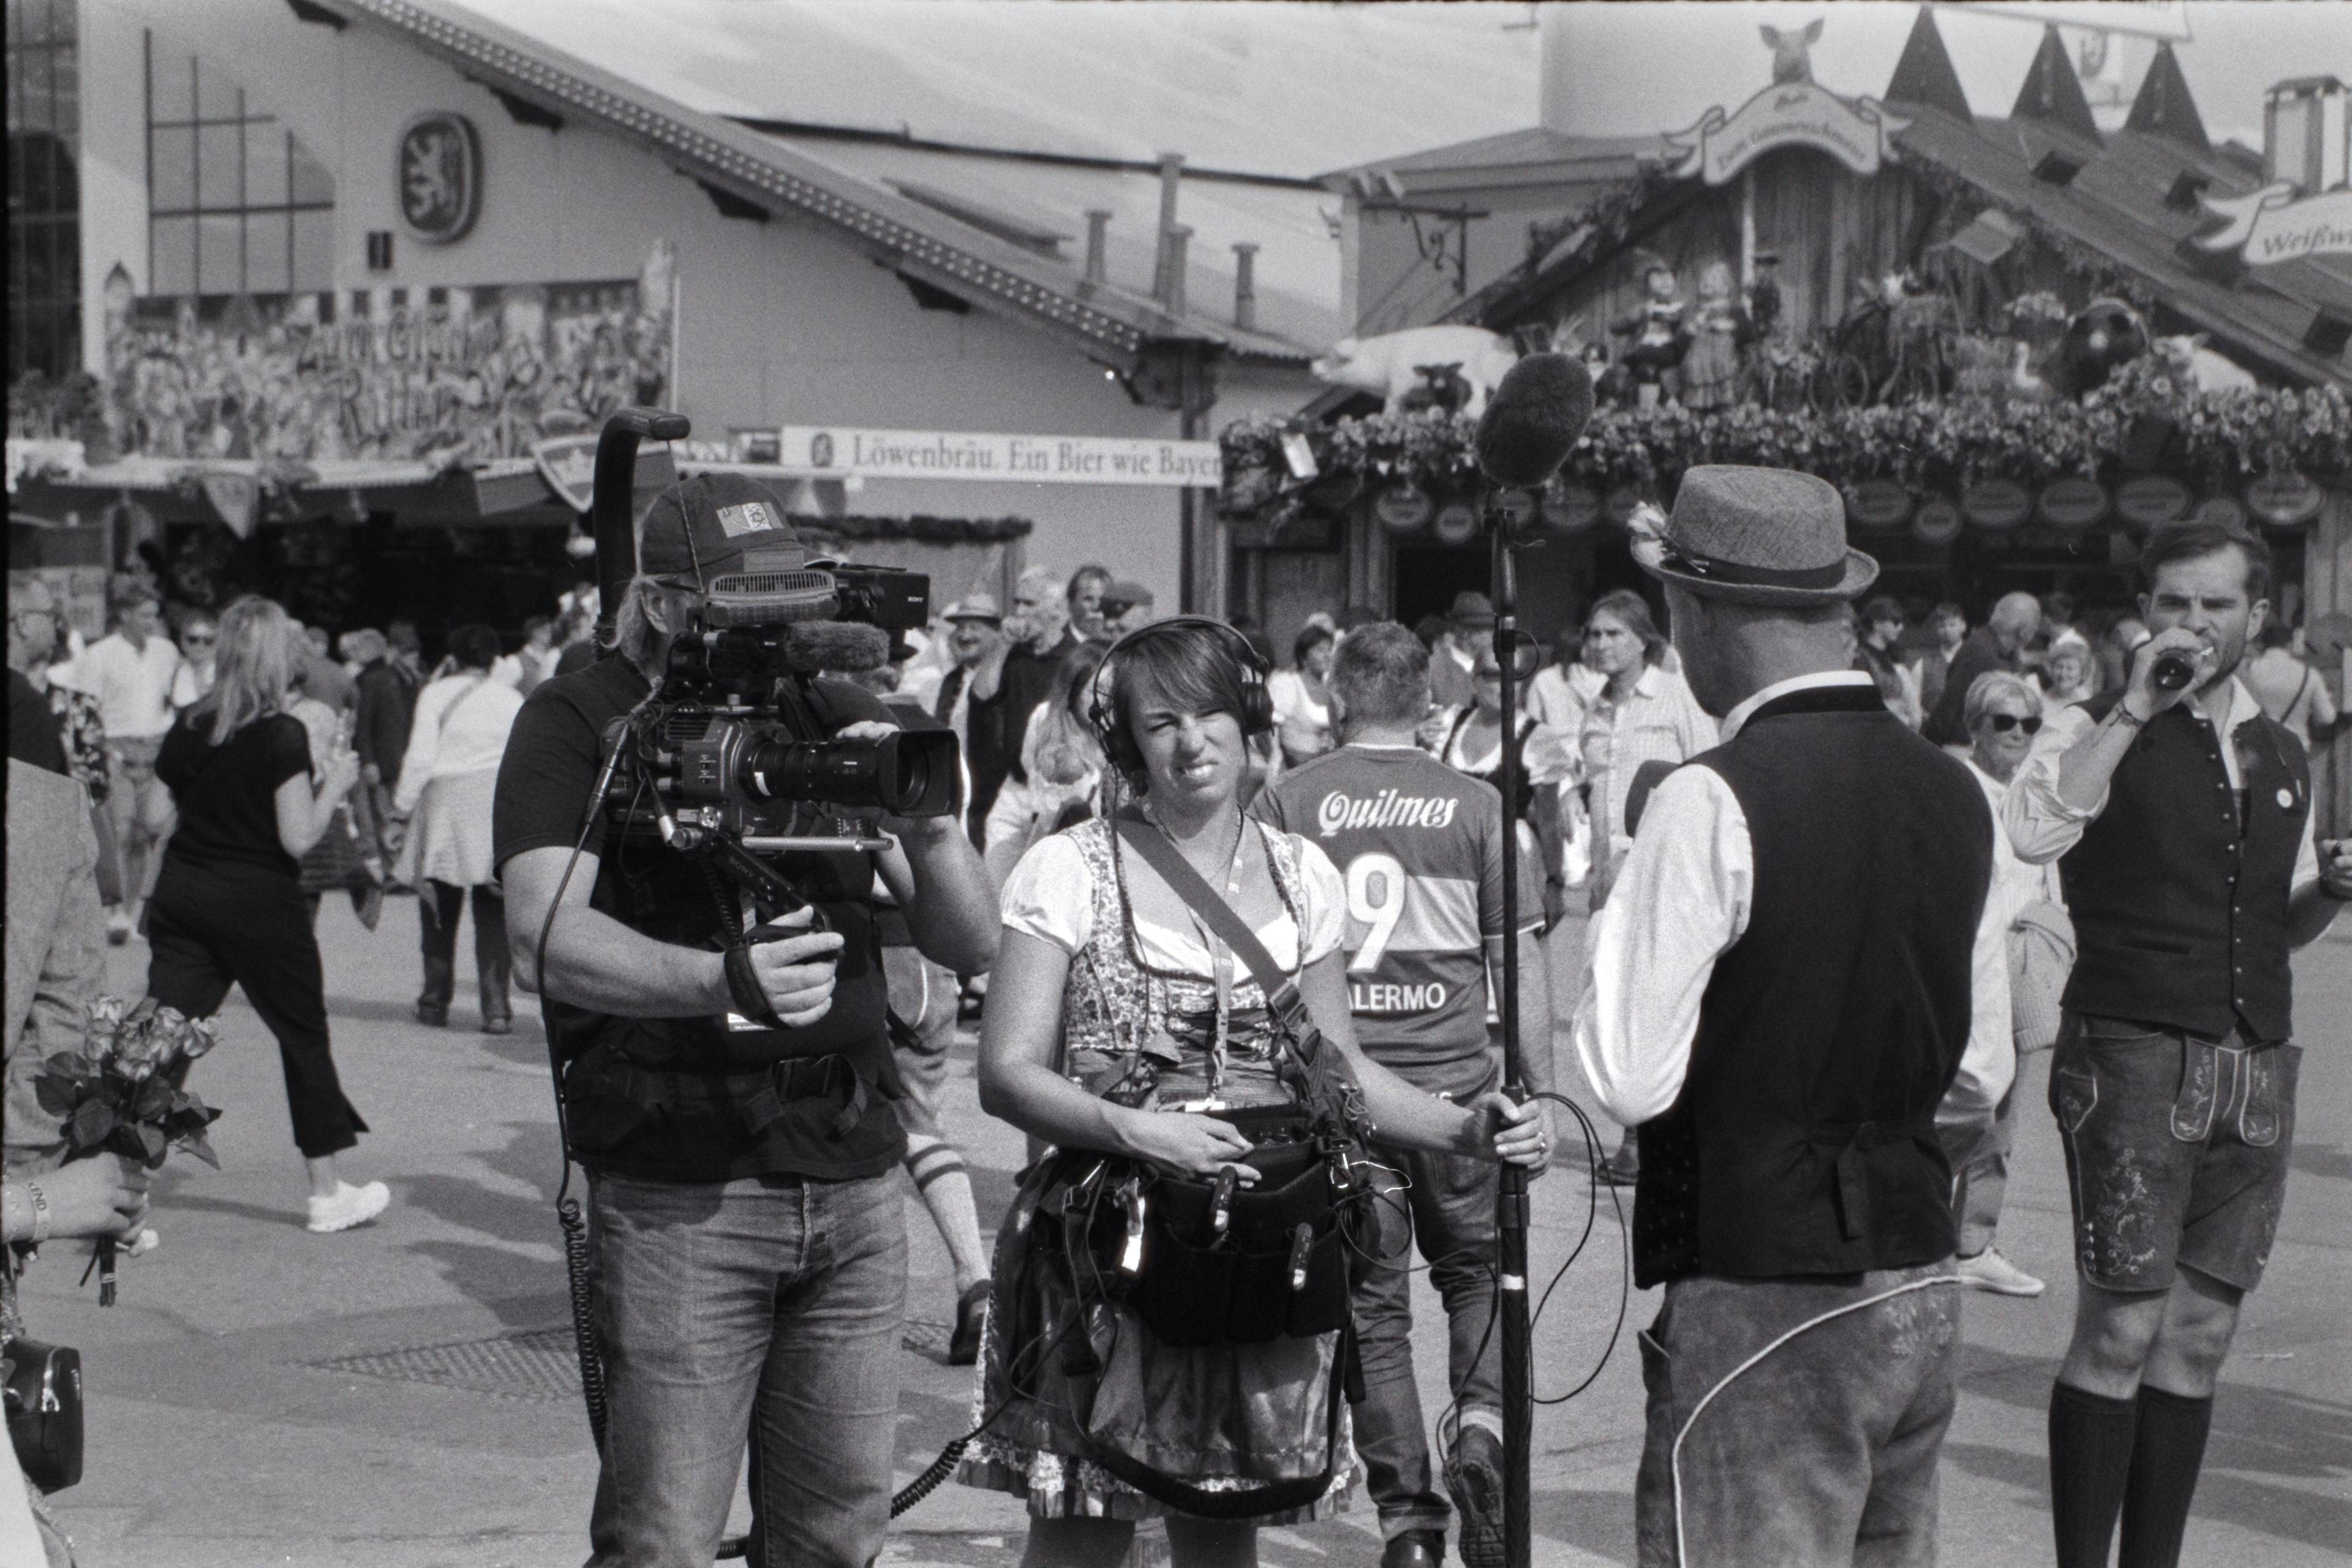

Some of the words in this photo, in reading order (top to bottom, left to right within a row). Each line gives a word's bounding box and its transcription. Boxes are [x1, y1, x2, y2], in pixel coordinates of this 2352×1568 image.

[1009, 438, 1049, 472] Ein
[1058, 441, 1103, 474] Bier
[1112, 445, 1151, 475] wie
[1319, 788, 1459, 838] Quilmes
[1346, 851, 1407, 973] 9
[1348, 982, 1446, 1011] LERMO
